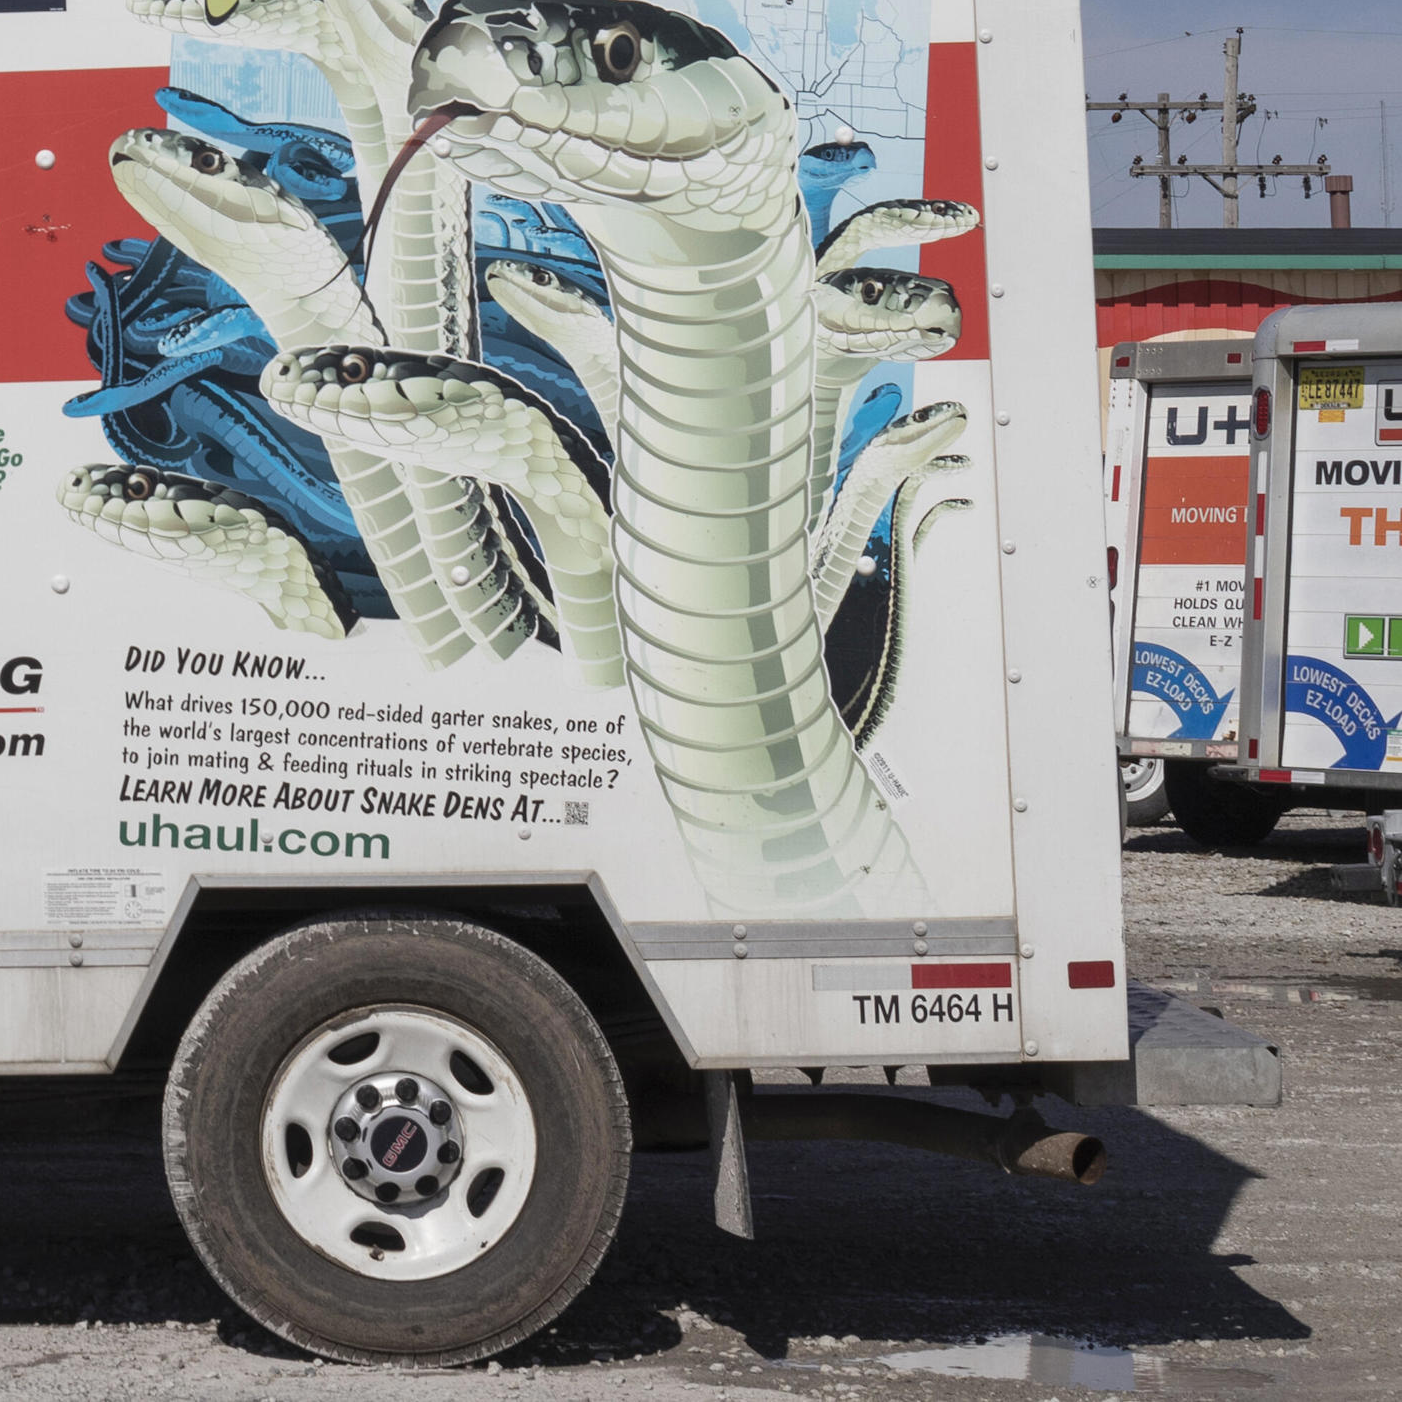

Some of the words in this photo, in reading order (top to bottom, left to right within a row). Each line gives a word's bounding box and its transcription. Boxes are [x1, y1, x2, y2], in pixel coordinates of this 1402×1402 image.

[1171, 506, 1237, 524] MOVING
[1174, 598, 1218, 610] HOLDS
[1195, 580, 1210, 592] #1
[1172, 616, 1217, 628] CLEAN
[1210, 635, 1232, 647] E-Z
[1135, 650, 1185, 678] LOWEST
[1183, 673, 1214, 715] DECKS
[1146, 671, 1193, 711] EZ-LOAD
[1293, 665, 1347, 697] LOWEST
[1346, 692, 1381, 740] DECKS
[125, 691, 173, 712] What
[180, 693, 233, 715] drives
[240, 697, 331, 721] 150,000
[338, 702, 423, 725] red-sided
[431, 710, 484, 730] garter
[492, 712, 559, 735] snakes,
[566, 718, 597, 733] one
[605, 715, 626, 736] of
[1305, 689, 1357, 736] EZ-LOAD
[123, 719, 151, 739] the
[159, 721, 222, 741] world's
[229, 723, 291, 747] largest
[297, 730, 428, 752] concentrations
[435, 734, 457, 754] of
[462, 737, 553, 760] vertebrate
[561, 743, 633, 767] species,
[122, 748, 139, 765] to
[146, 748, 179, 771] join
[187, 752, 249, 775] mating
[257, 753, 274, 772] &
[282, 753, 349, 780] feeding
[356, 758, 413, 779] rituals
[421, 762, 437, 780] in
[445, 762, 512, 788] striking
[519, 768, 619, 790] spectacle?
[118, 814, 391, 859] uhaul.com
[852, 994, 900, 1024] TM
[911, 993, 982, 1024] 6464
[993, 993, 1014, 1023] H
[382, 1121, 418, 1167] GMC
